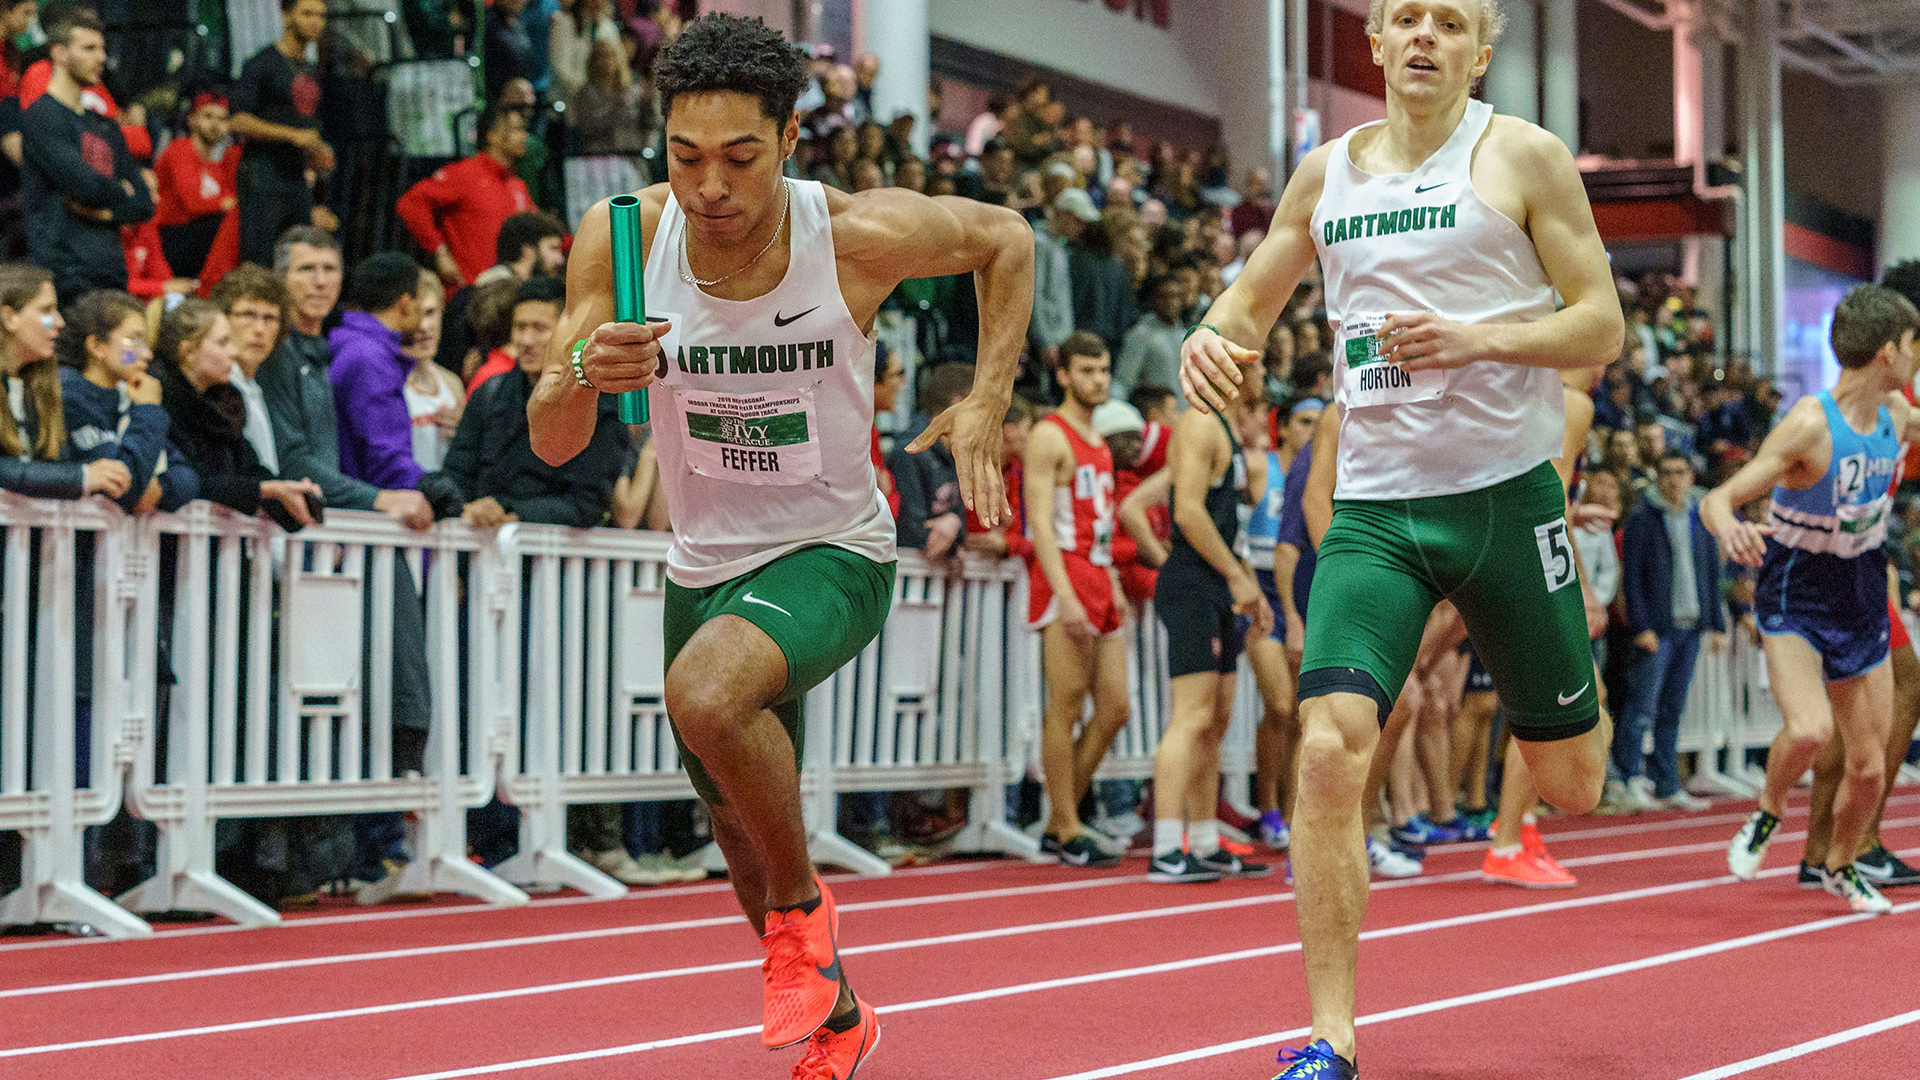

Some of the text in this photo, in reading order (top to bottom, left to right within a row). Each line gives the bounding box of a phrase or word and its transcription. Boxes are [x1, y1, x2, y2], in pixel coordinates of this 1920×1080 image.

[1324, 204, 1457, 247] DARTMOUTH
[677, 339, 834, 375] ARTMOUTH
[1360, 365, 1411, 391] HORTON
[709, 401, 727, 409] TRACK
[754, 397, 800, 410] CHAMPIONSHIPS
[761, 408, 779, 416] TRACK
[733, 424, 769, 440] IVY
[720, 446, 780, 472] FEFFER
[1848, 459, 1860, 492] 2
[1547, 523, 1570, 586] 5
